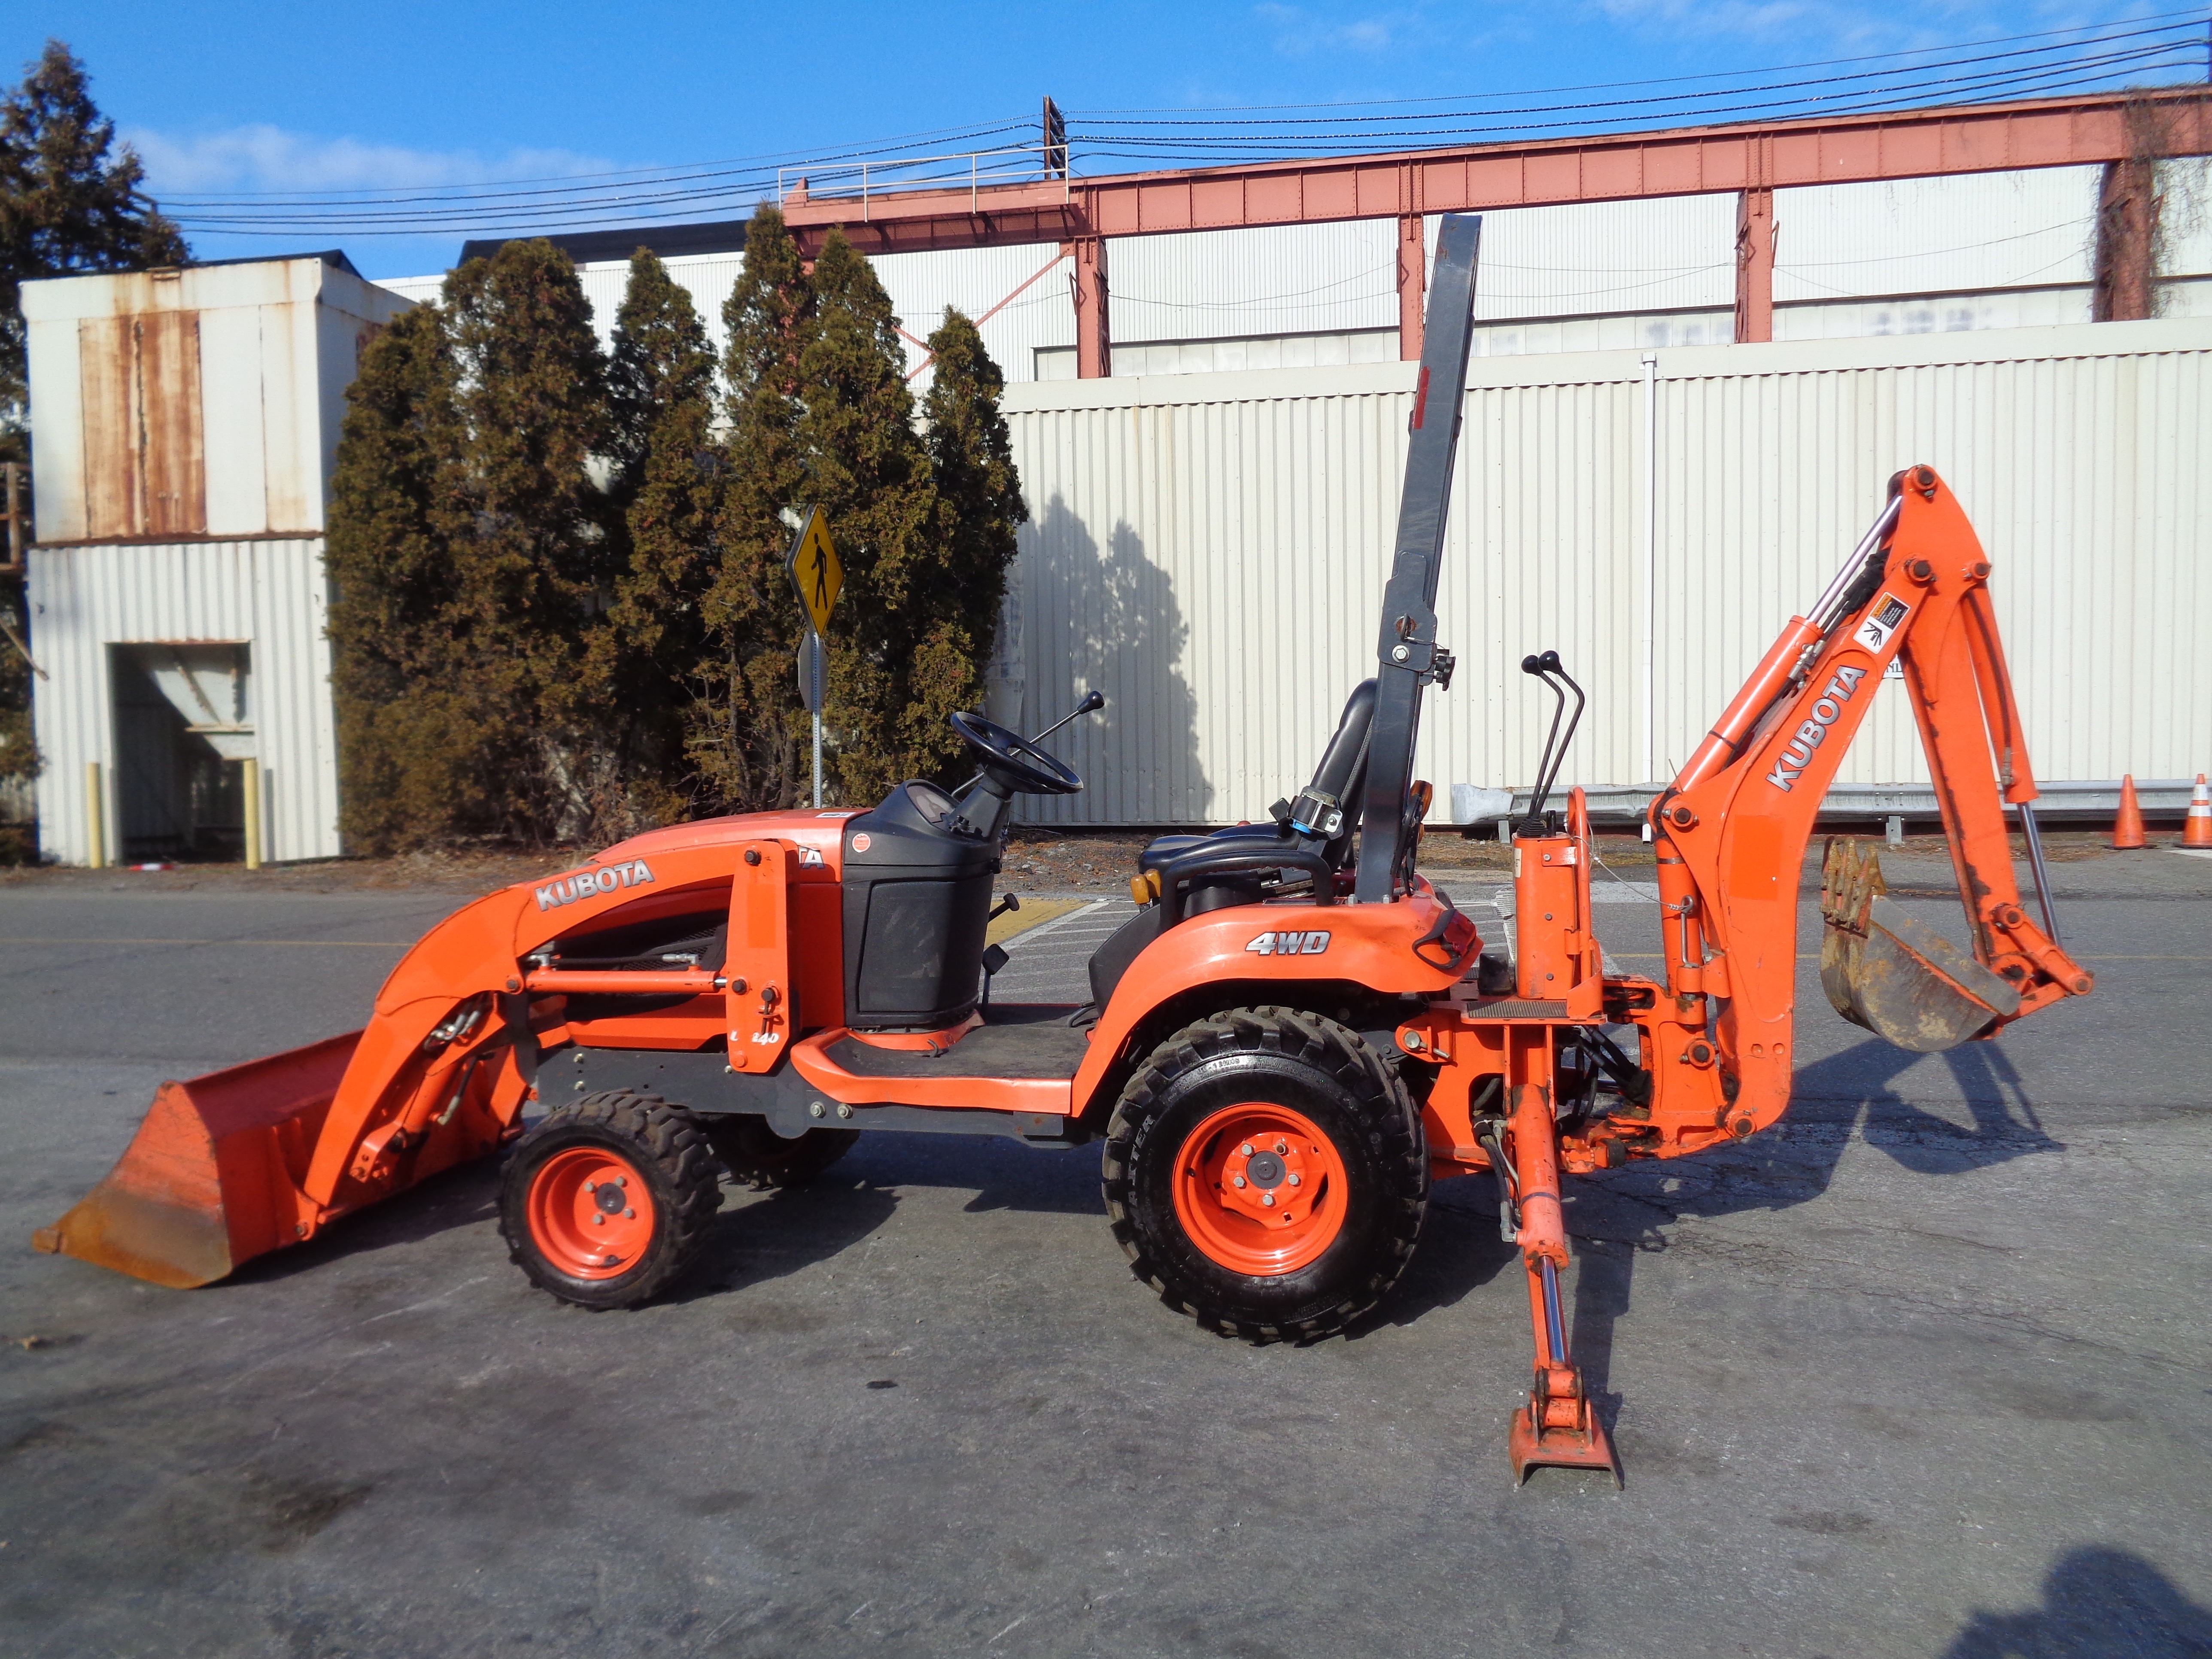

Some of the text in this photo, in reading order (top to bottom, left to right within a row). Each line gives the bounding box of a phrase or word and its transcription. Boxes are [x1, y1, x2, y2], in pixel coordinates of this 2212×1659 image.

[1765, 665, 1868, 793] KUBOTA
[534, 858, 655, 912] KUBOTA
[1245, 930, 1331, 956] 4WD
[751, 1032, 779, 1046] 240
